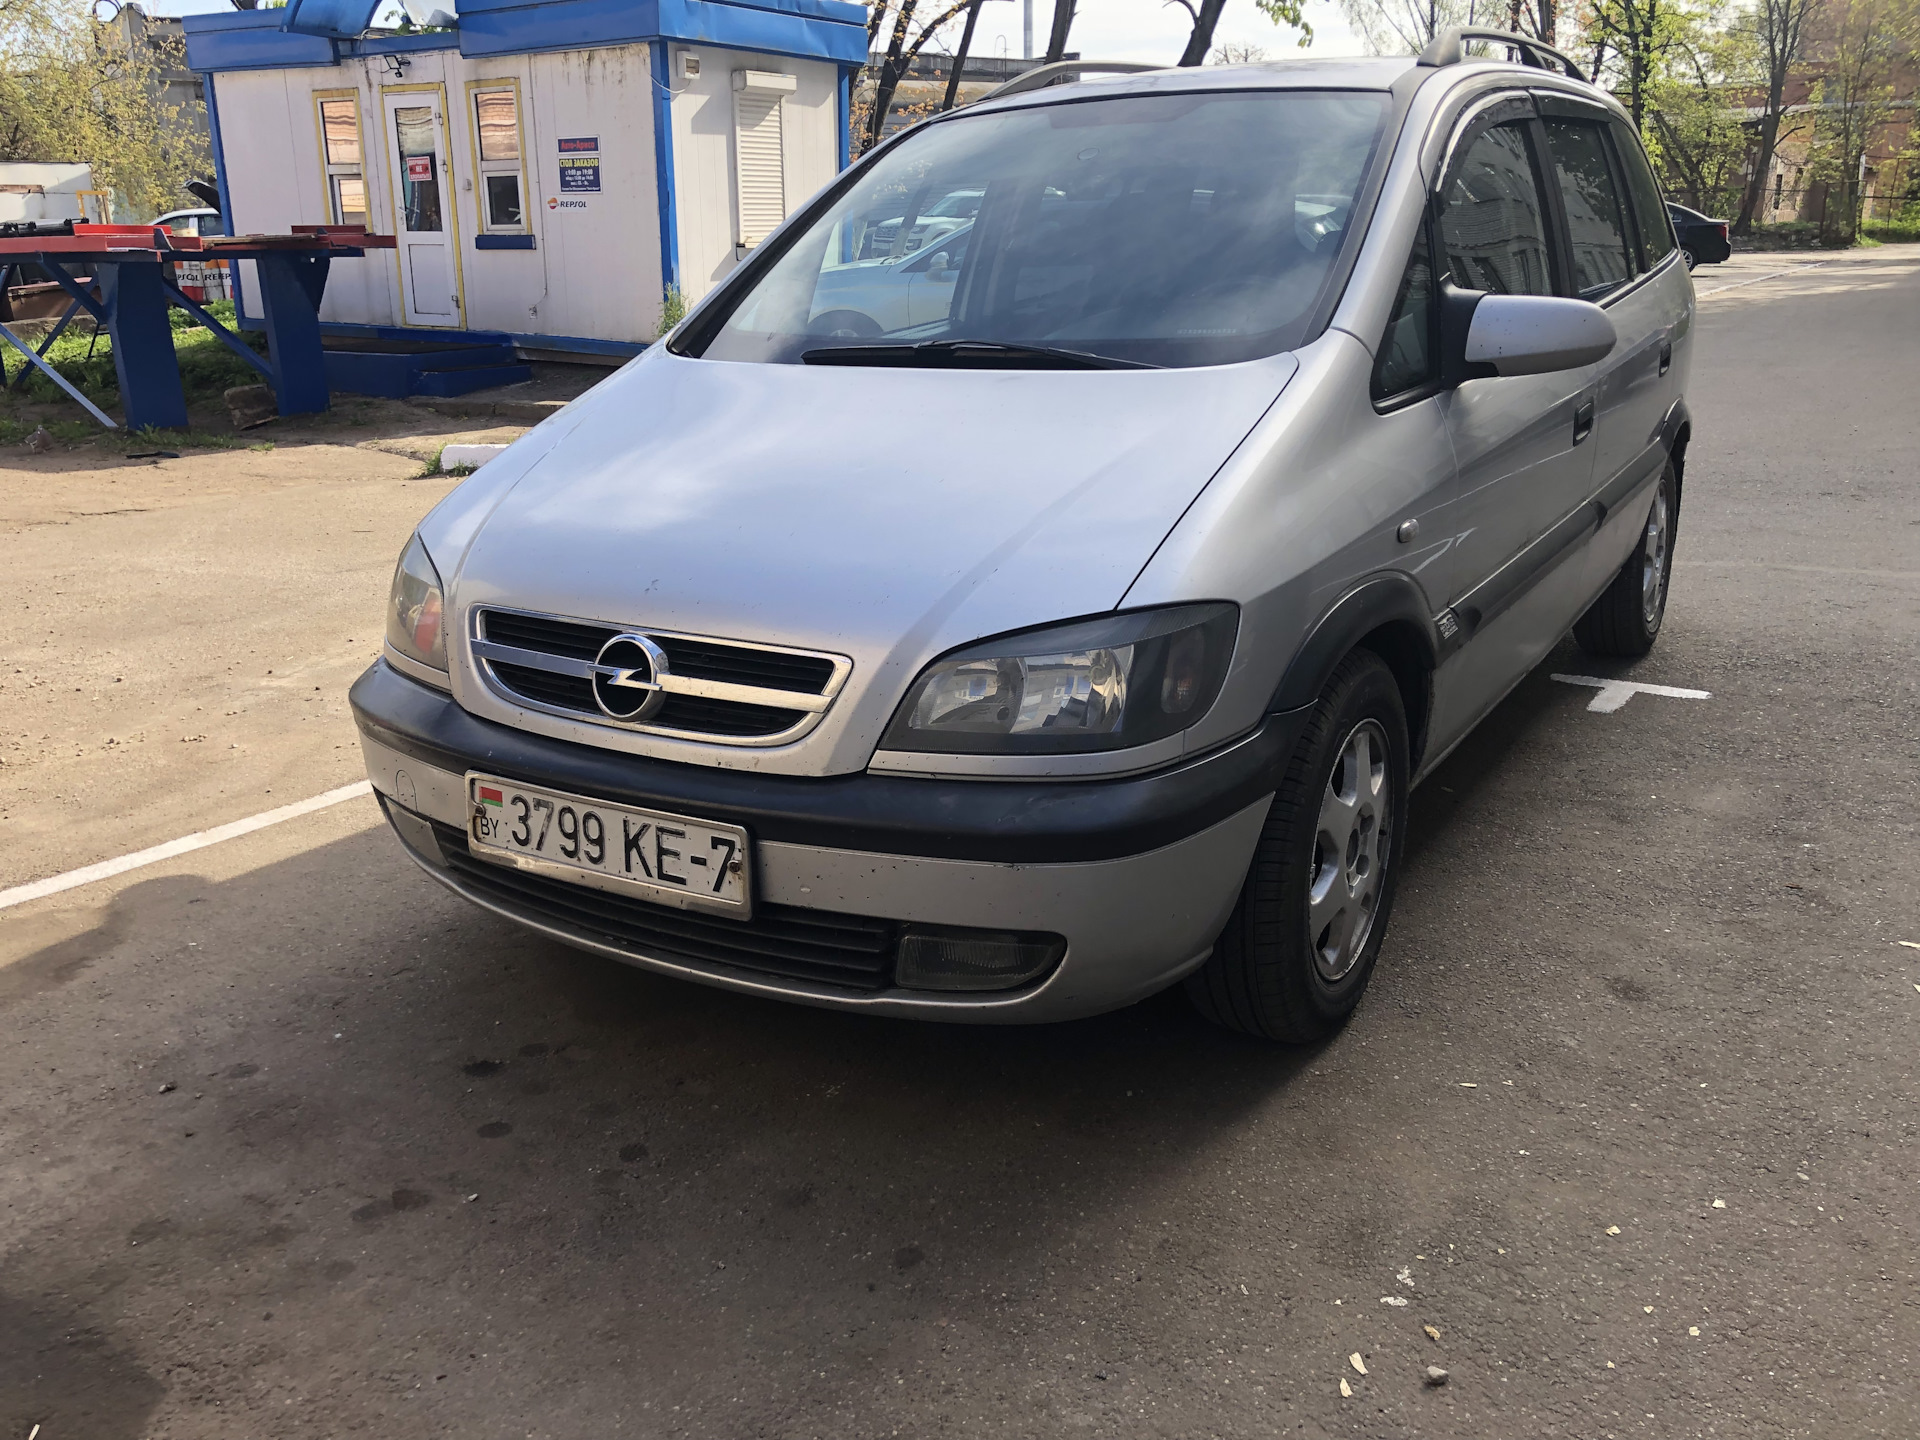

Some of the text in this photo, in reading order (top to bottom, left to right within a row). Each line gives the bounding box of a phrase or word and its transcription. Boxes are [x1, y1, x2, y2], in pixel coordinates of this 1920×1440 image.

[574, 159, 598, 167] ЗАКАЗОВ
[480, 817, 499, 839] BY
[511, 794, 737, 892] 3799 KE-7
